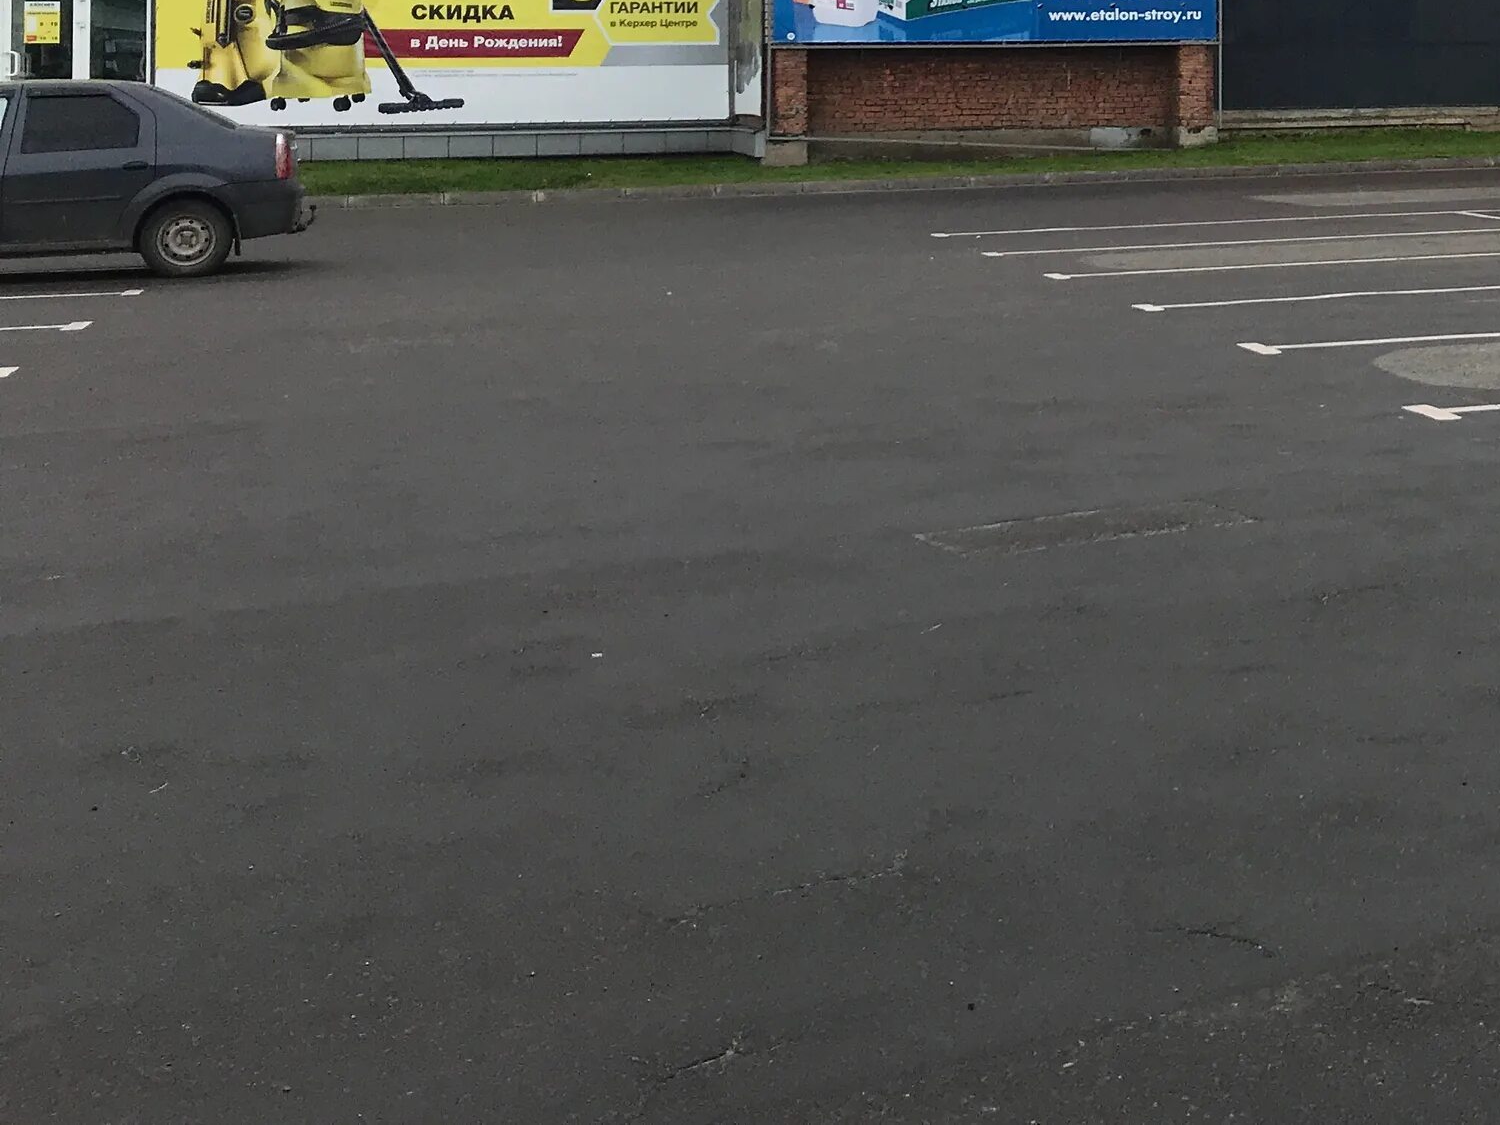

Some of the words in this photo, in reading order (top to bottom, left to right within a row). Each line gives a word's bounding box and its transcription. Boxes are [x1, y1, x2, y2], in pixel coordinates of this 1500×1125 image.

[411, 4, 515, 24] СКИДКА
[610, 1, 699, 15] ГАРАНТИИ
[1048, 7, 1202, 24] www.etalon-stroy.ru
[618, 19, 658, 29] Керхер
[660, 19, 698, 29] Центре
[410, 38, 421, 48] в
[424, 35, 468, 50] День
[473, 36, 563, 49] Рождения!
